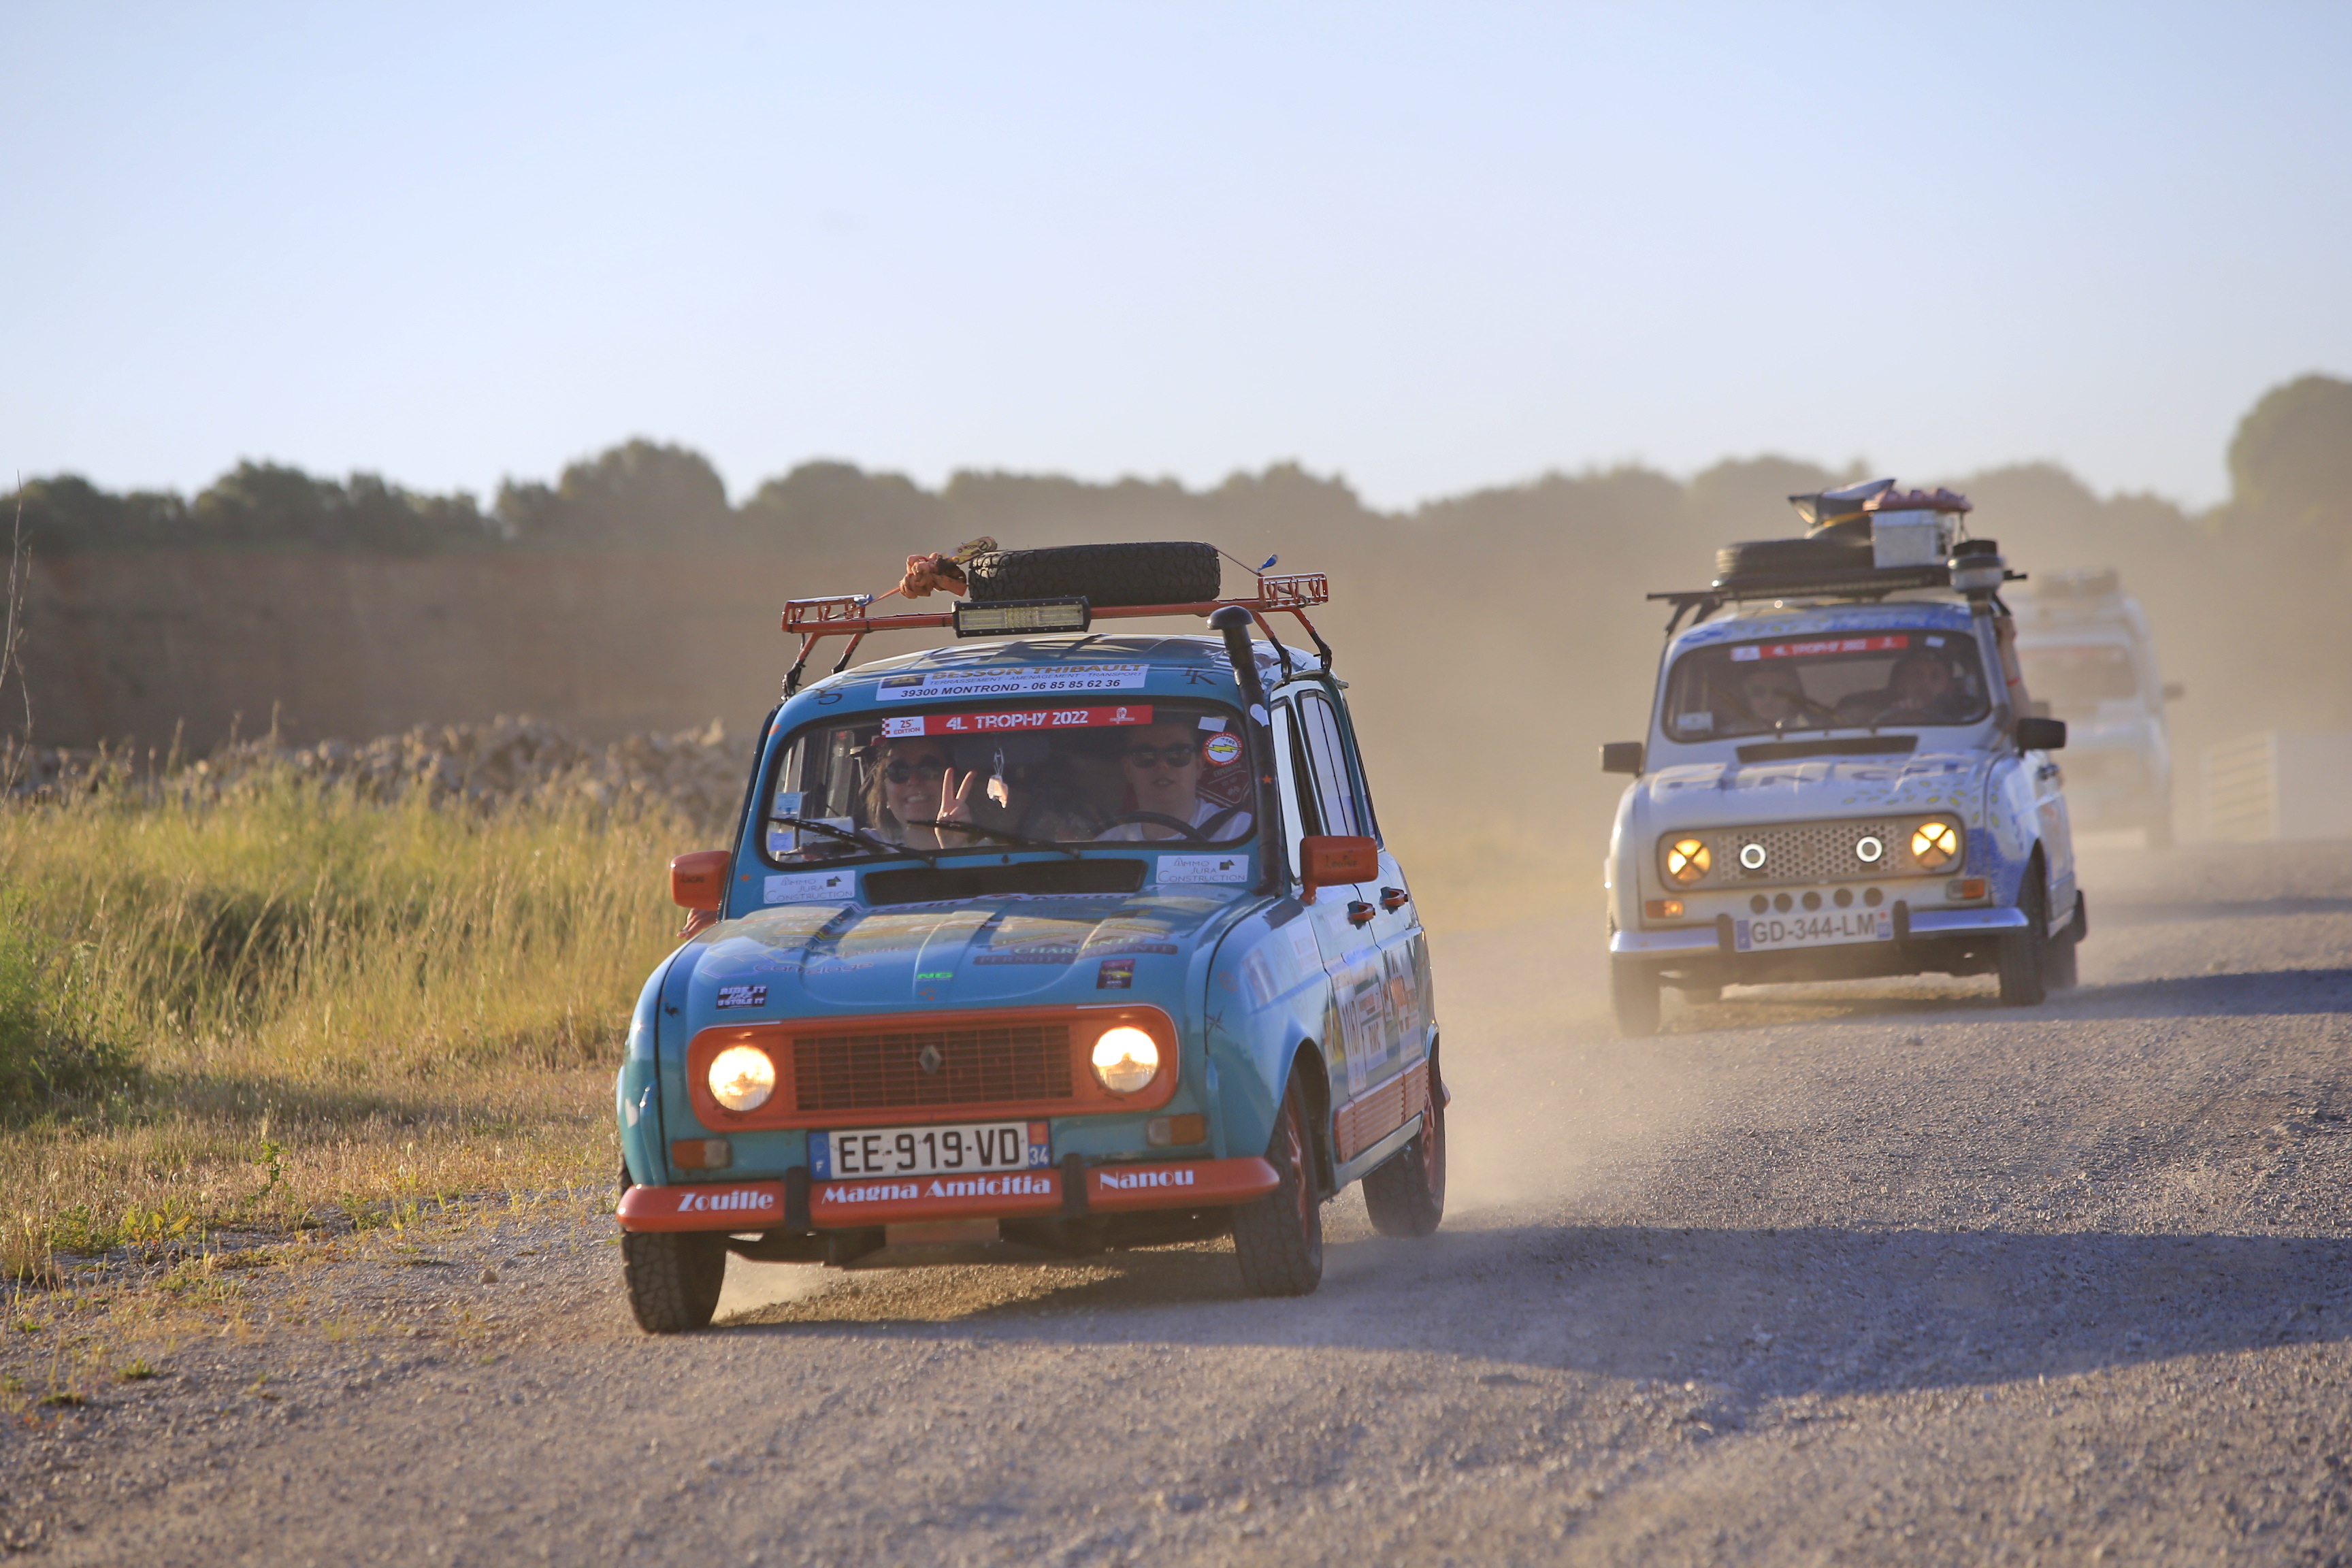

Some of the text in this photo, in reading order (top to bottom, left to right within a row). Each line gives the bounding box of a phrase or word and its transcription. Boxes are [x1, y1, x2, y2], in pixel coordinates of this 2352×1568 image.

[930, 676, 1002, 685] TERRASSEMENT
[1009, 673, 1081, 681] AMENAGEMENT
[932, 664, 1145, 680] BESSON THIBAULT
[900, 688, 938, 698] 39300
[941, 683, 1019, 695] MONTROND
[1031, 682, 1046, 690] 06
[1050, 681, 1065, 689] 85
[1068, 680, 1083, 688] 85
[946, 710, 1088, 730] 4L TROPHY 2022
[1158, 870, 1245, 883] CONSTRUCTION
[765, 890, 853, 902] CONSTRUCTION
[798, 885, 824, 893] JURA
[1752, 913, 1875, 943] GD-344-LM
[719, 987, 749, 995] RIDE
[838, 1128, 1020, 1174] EE-919-VD
[1028, 1147, 1049, 1165] 34
[815, 1160, 823, 1172] F
[1100, 1169, 1194, 1191] Nanou
[821, 1176, 1051, 1205] Magna Amicitia
[677, 1191, 774, 1212] Zouille
